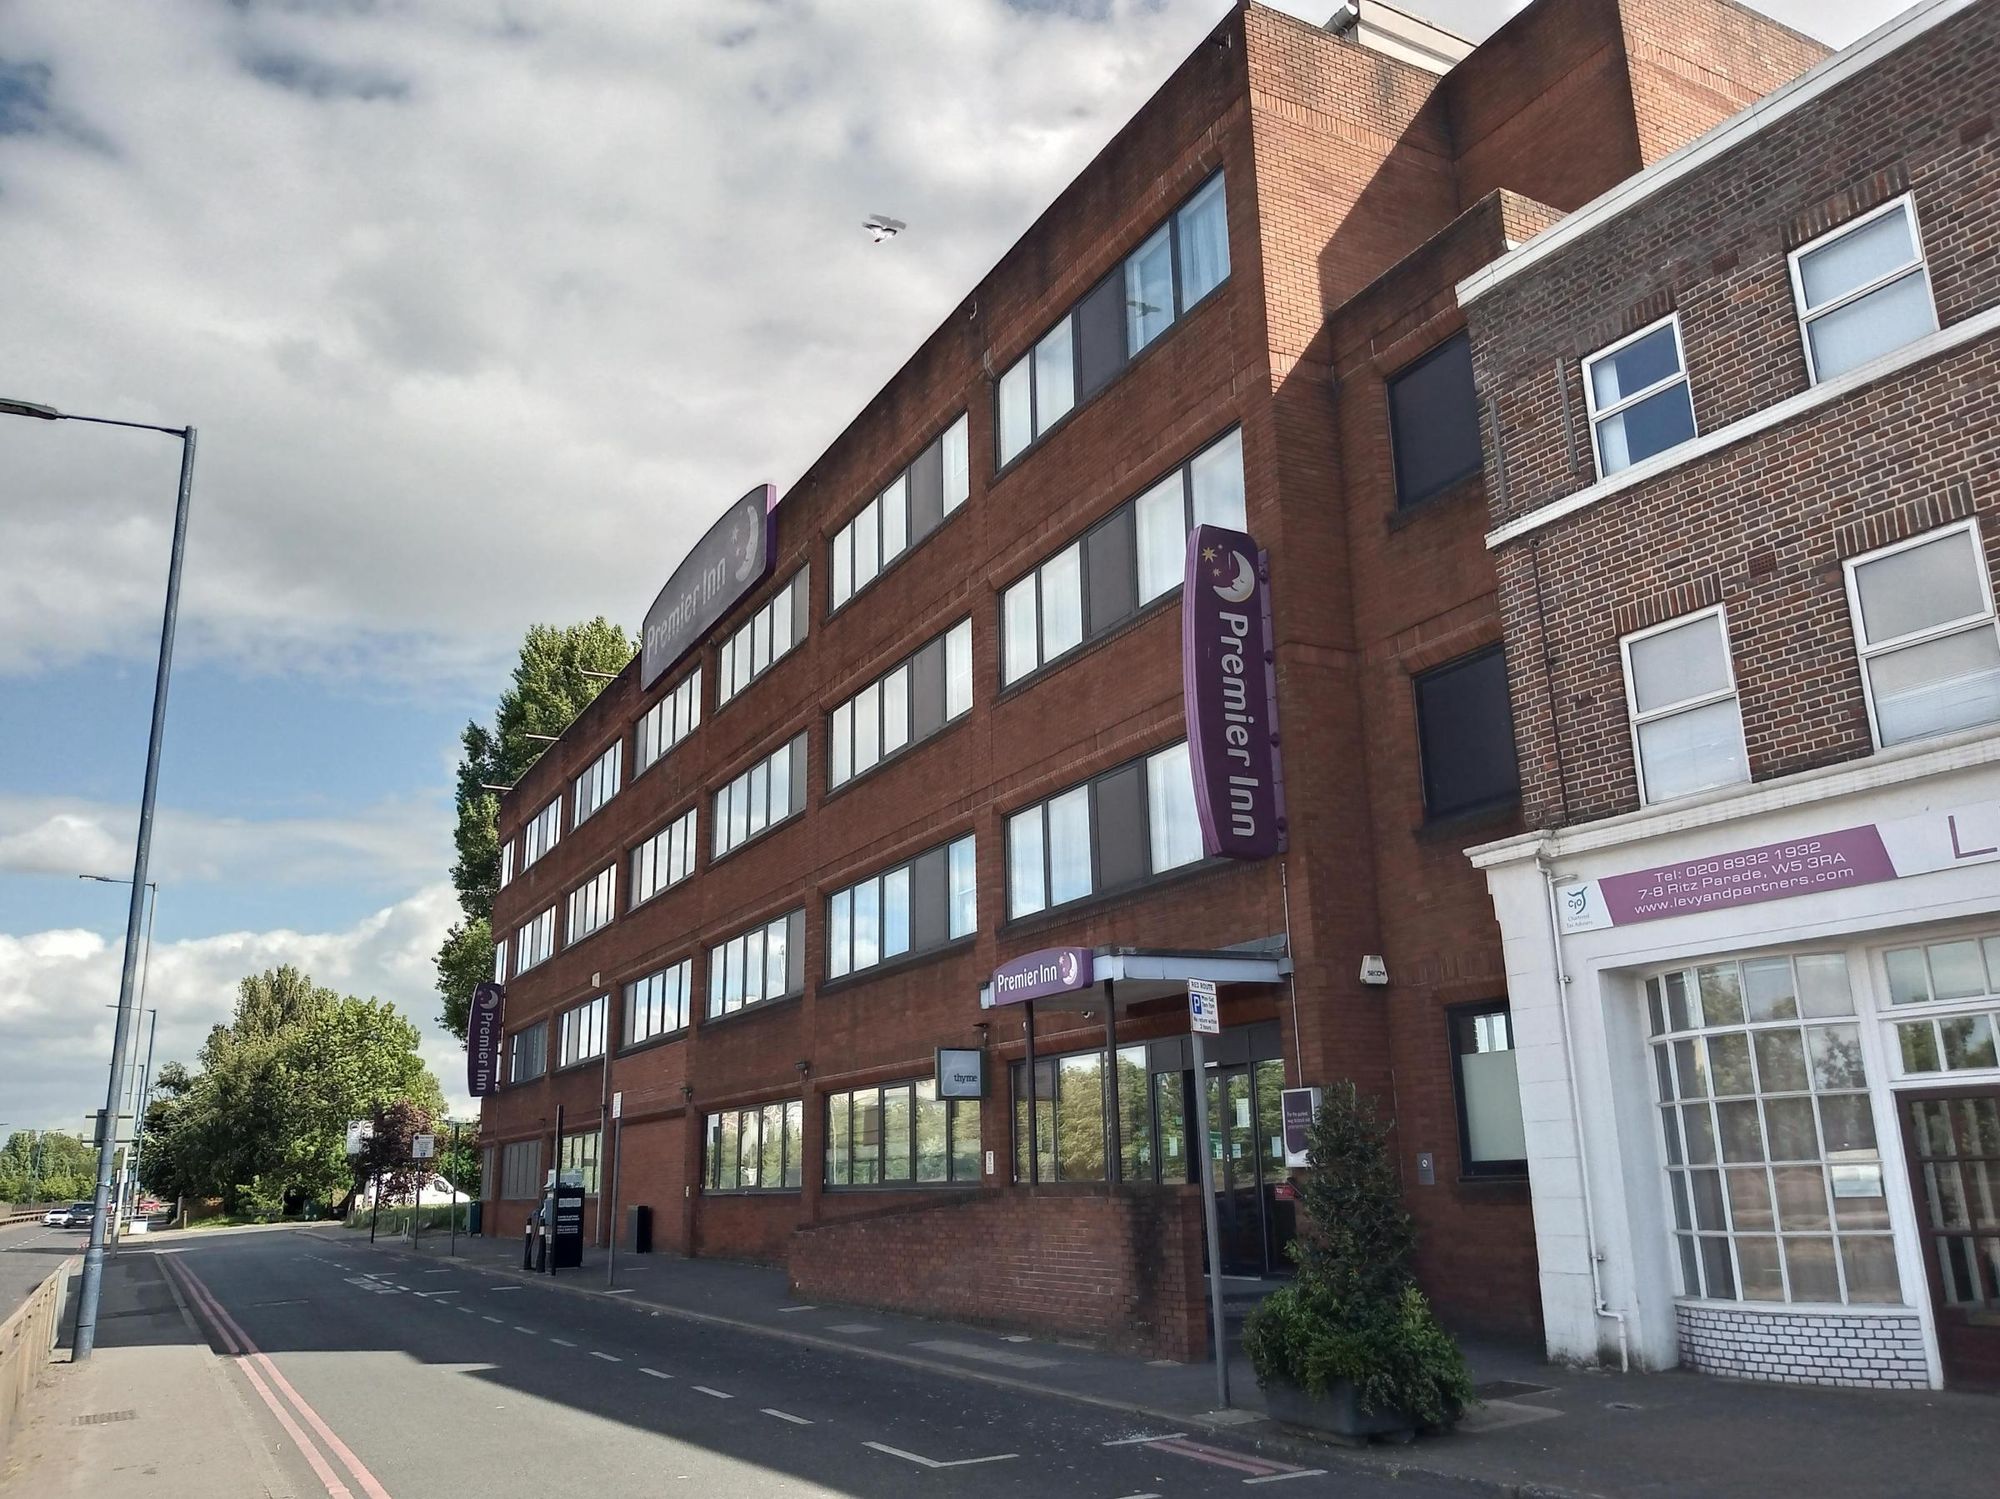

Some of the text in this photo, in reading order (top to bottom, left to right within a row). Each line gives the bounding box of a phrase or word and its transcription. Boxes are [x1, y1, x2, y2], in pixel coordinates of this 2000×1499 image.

[646, 557, 726, 664] Premier Inn
[1219, 610, 1259, 837] Premier Inn
[1638, 852, 1847, 900] 7-8 Ritz Parade, W5 3RA
[1654, 841, 1822, 883] Tel: 020 8932 1932
[1634, 866, 1854, 914] www.levyandpartners.com
[997, 964, 1057, 993] Premier Inn
[476, 1012, 494, 1090] Premier Inn
[954, 1073, 978, 1084] thyme
